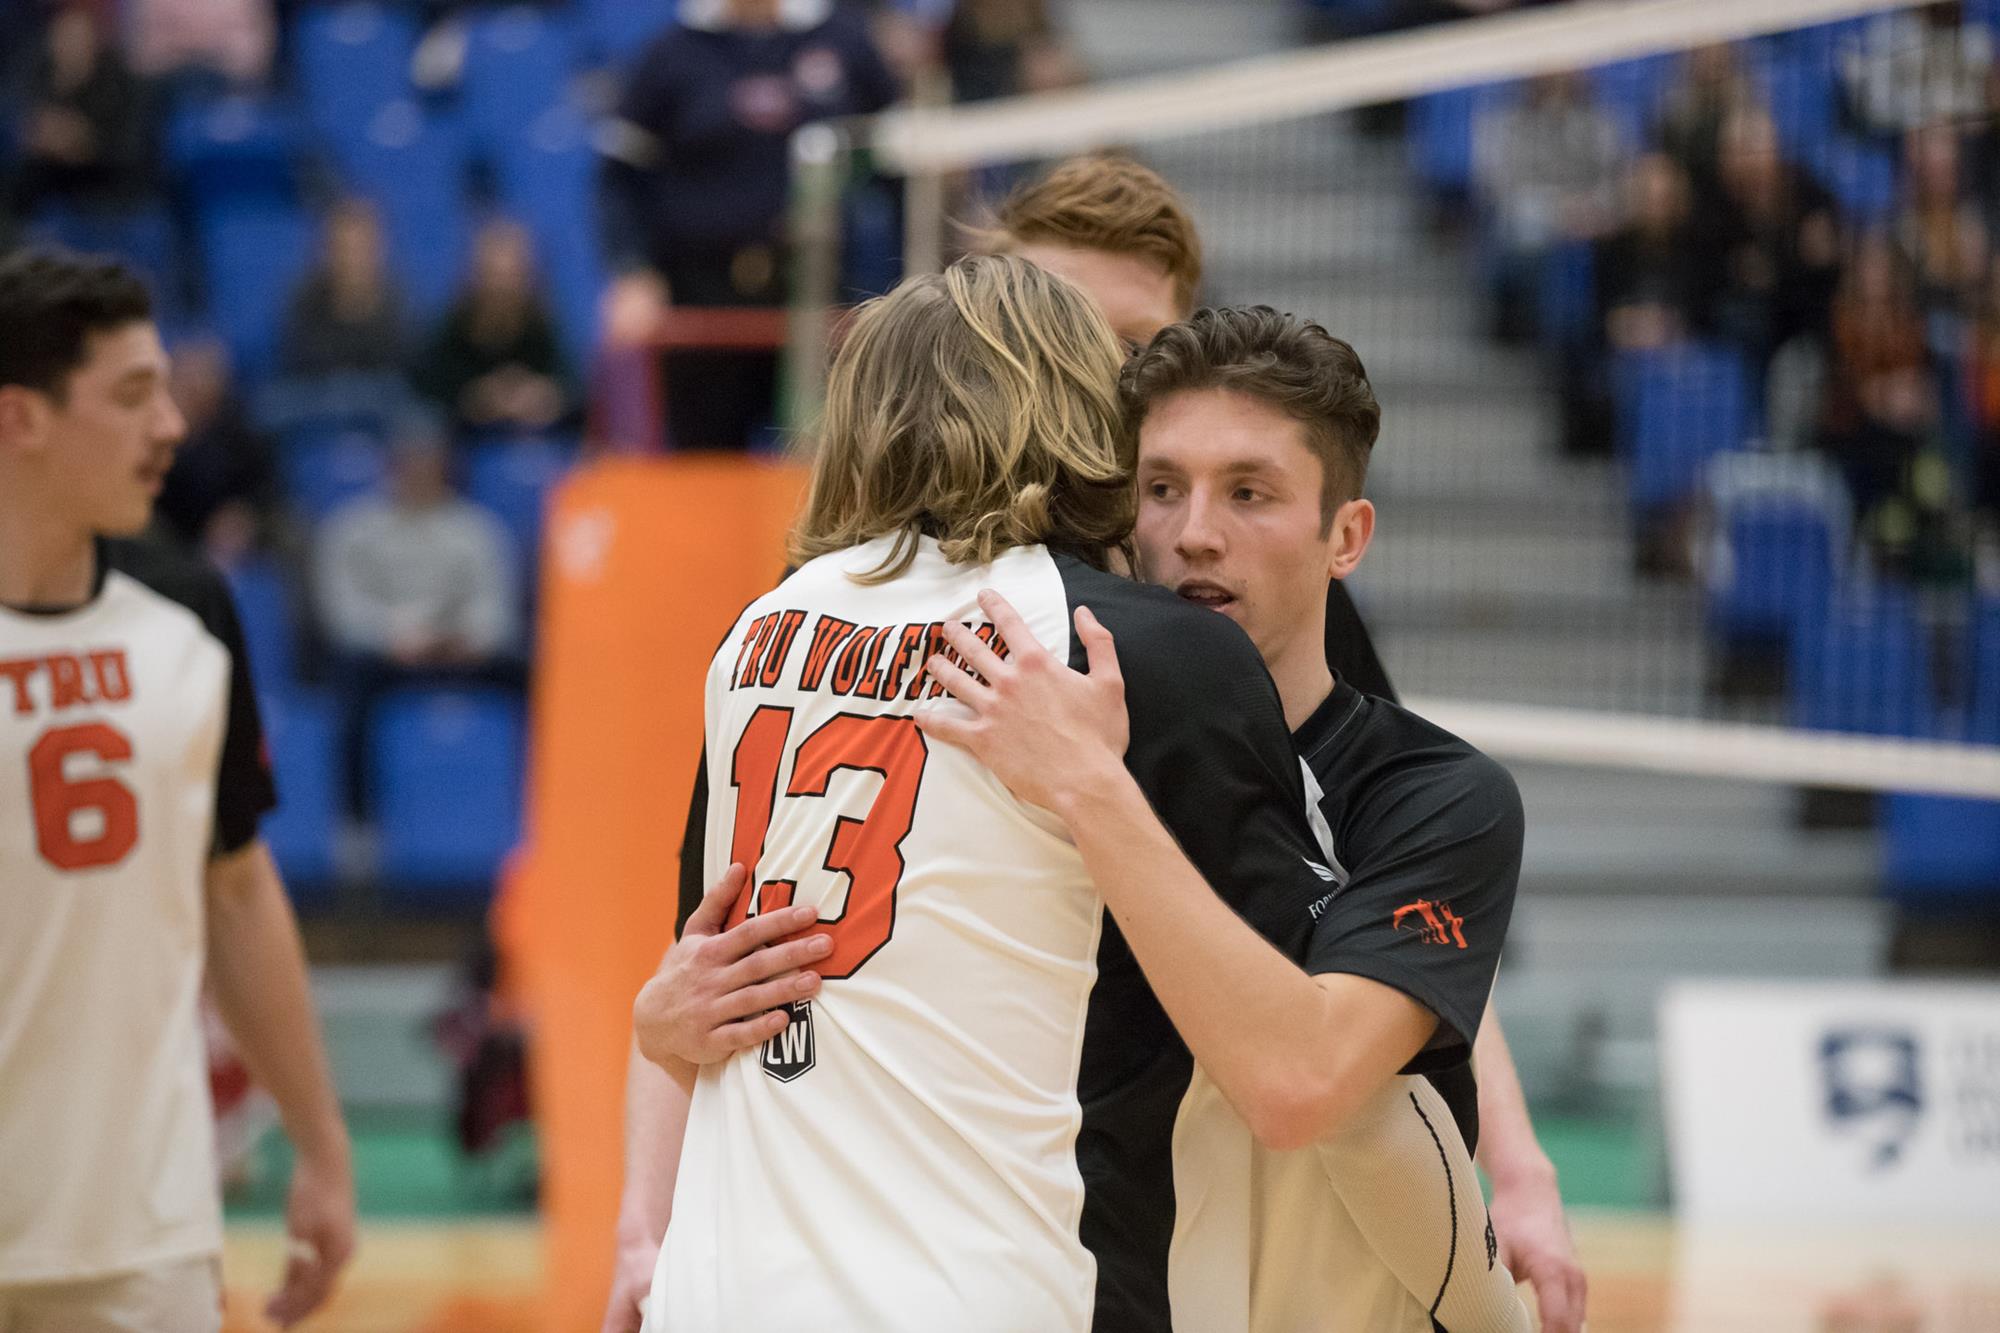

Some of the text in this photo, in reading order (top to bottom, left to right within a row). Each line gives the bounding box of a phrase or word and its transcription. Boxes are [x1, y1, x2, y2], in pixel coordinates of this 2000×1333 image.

[0, 650, 132, 714] TRU
[729, 609, 1010, 701] TRU WOLFP
[29, 722, 139, 870] 6
[726, 705, 928, 979] 13
